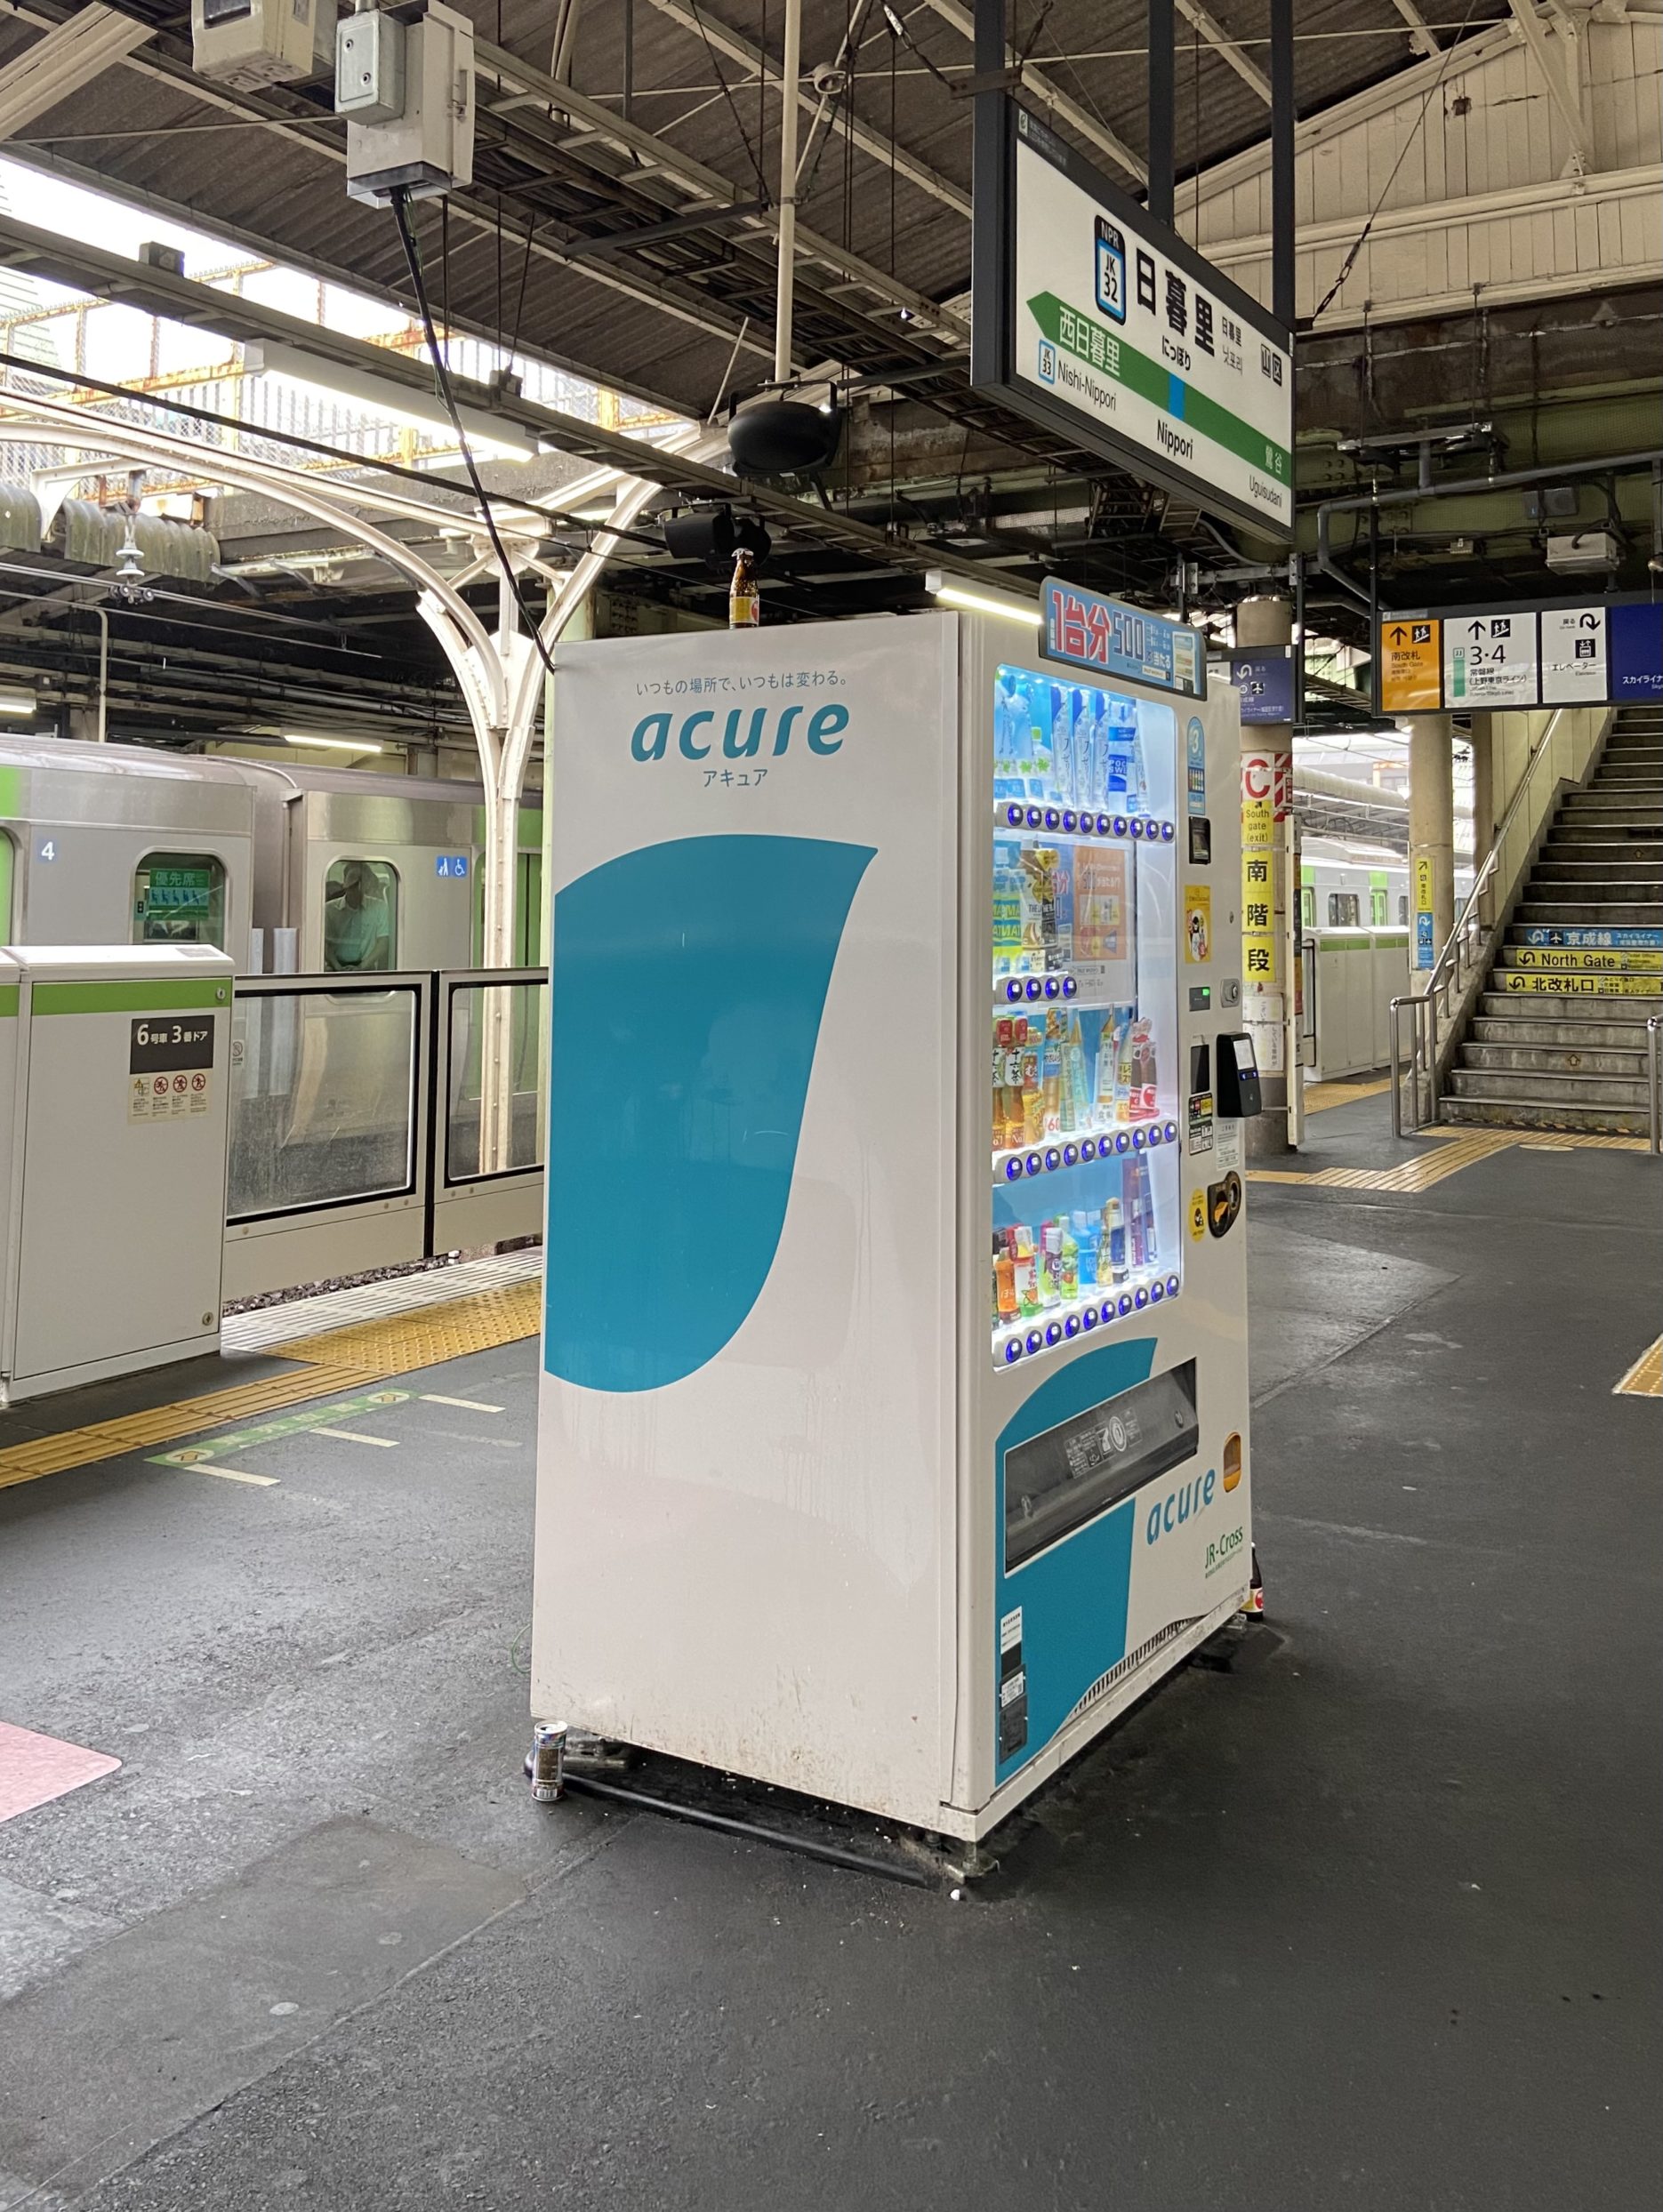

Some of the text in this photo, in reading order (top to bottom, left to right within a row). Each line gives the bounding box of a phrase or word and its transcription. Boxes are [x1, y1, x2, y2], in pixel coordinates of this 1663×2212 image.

[1101, 220, 1120, 251] NPR
[1105, 253, 1116, 276] JK
[1104, 272, 1118, 303] 32
[1136, 246, 1215, 357] 日暮里
[1059, 305, 1121, 378] 西日暮里
[1162, 335, 1192, 372] にっぽり
[1042, 357, 1052, 375] 33
[1057, 359, 1117, 411] Nishi-Nippori
[1157, 419, 1193, 461] Nippori
[1249, 474, 1282, 509] Uguisudani
[1391, 650, 1421, 661] 南改札
[1552, 661, 1596, 671] エレベーター
[636, 669, 847, 696] いつもの場所で、いつもは変わる。
[631, 703, 849, 763] acure
[703, 768, 768, 788] アキュア
[1246, 809, 1270, 819] South
[1248, 821, 1266, 830] gate
[1247, 831, 1269, 844] (exit)
[41, 841, 55, 861] 4
[156, 870, 196, 886] 優先席
[1246, 859, 1270, 972] 南階段
[1566, 931, 1612, 946] 京成線
[1541, 953, 1616, 967] North Gate
[1532, 977, 1595, 992] 北改札口
[137, 1023, 208, 1046] 6号車 3番ドア
[1146, 1469, 1216, 1545] acure
[1204, 1526, 1243, 1569] JR-Cross
